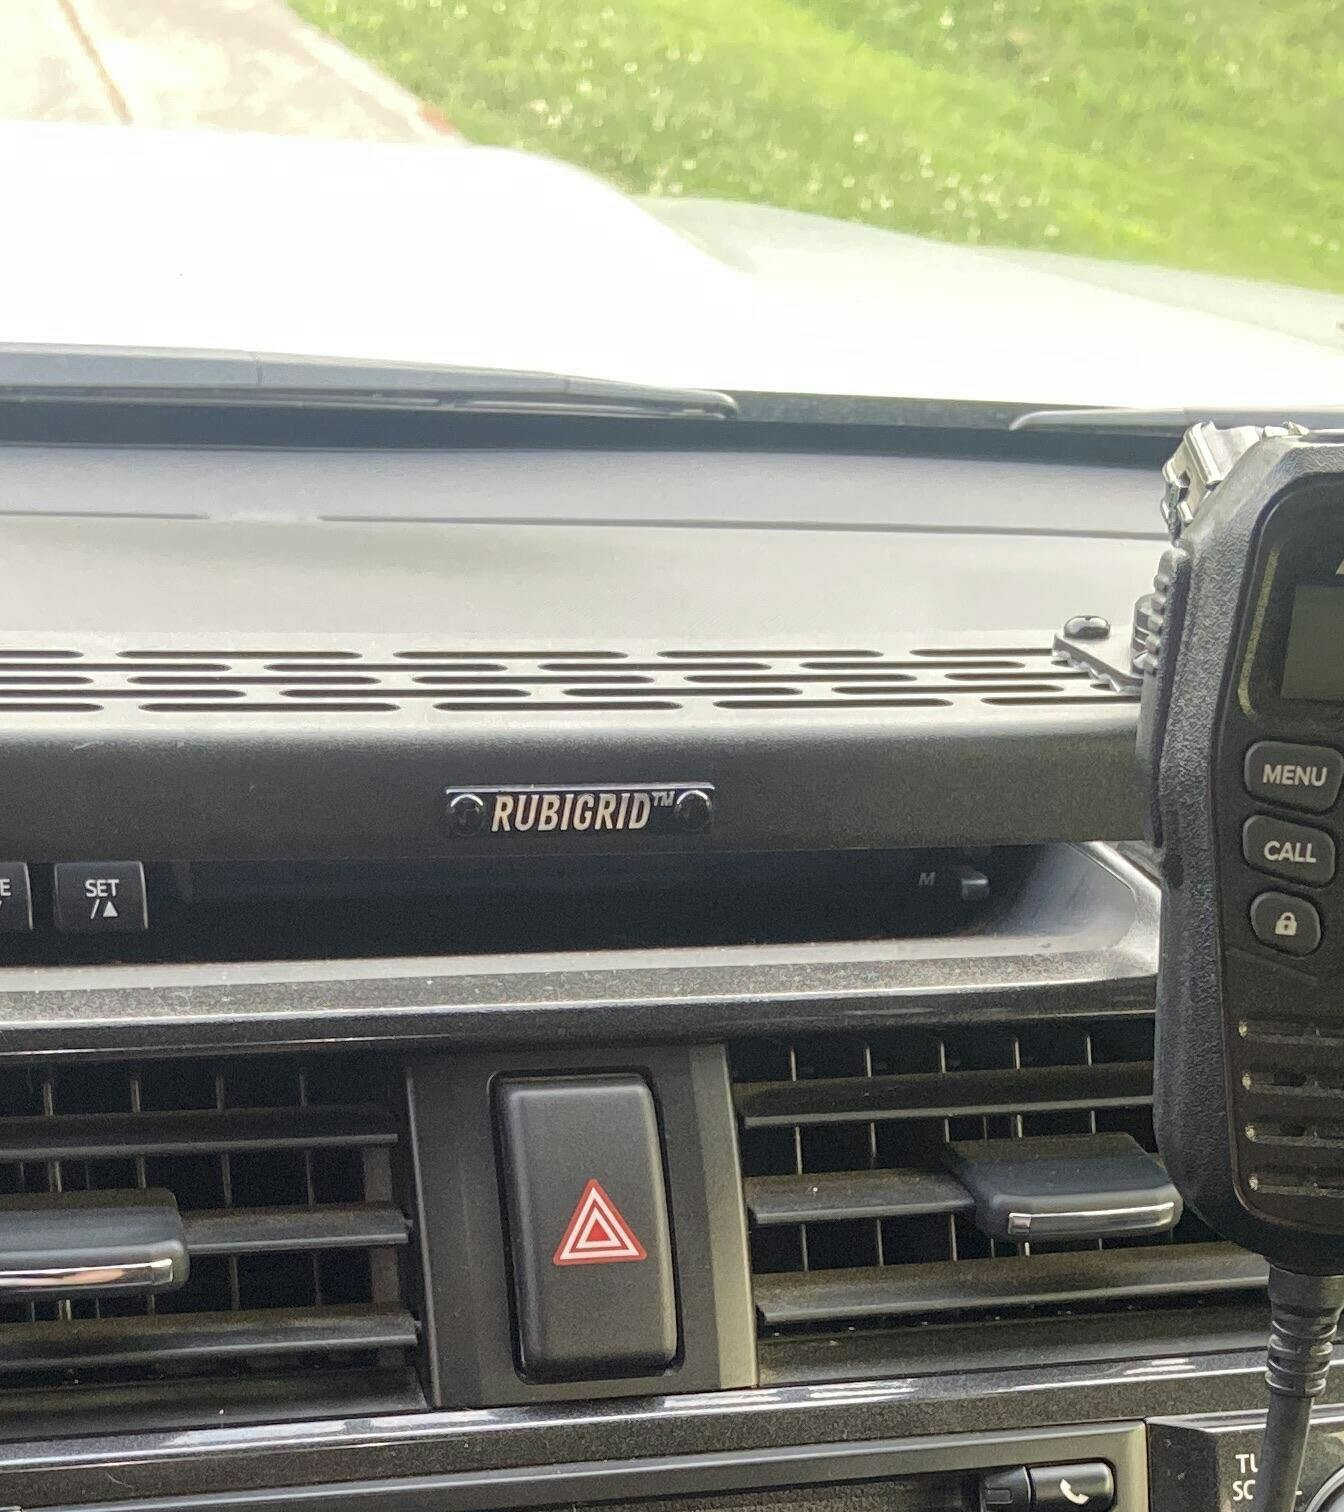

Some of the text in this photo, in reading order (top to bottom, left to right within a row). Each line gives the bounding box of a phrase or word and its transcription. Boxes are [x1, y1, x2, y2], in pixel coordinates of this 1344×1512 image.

[1262, 764, 1328, 787] MENU
[1264, 841, 1317, 863] CALL
[84, 878, 121, 898] SET
[1235, 1453, 1259, 1473] TU
